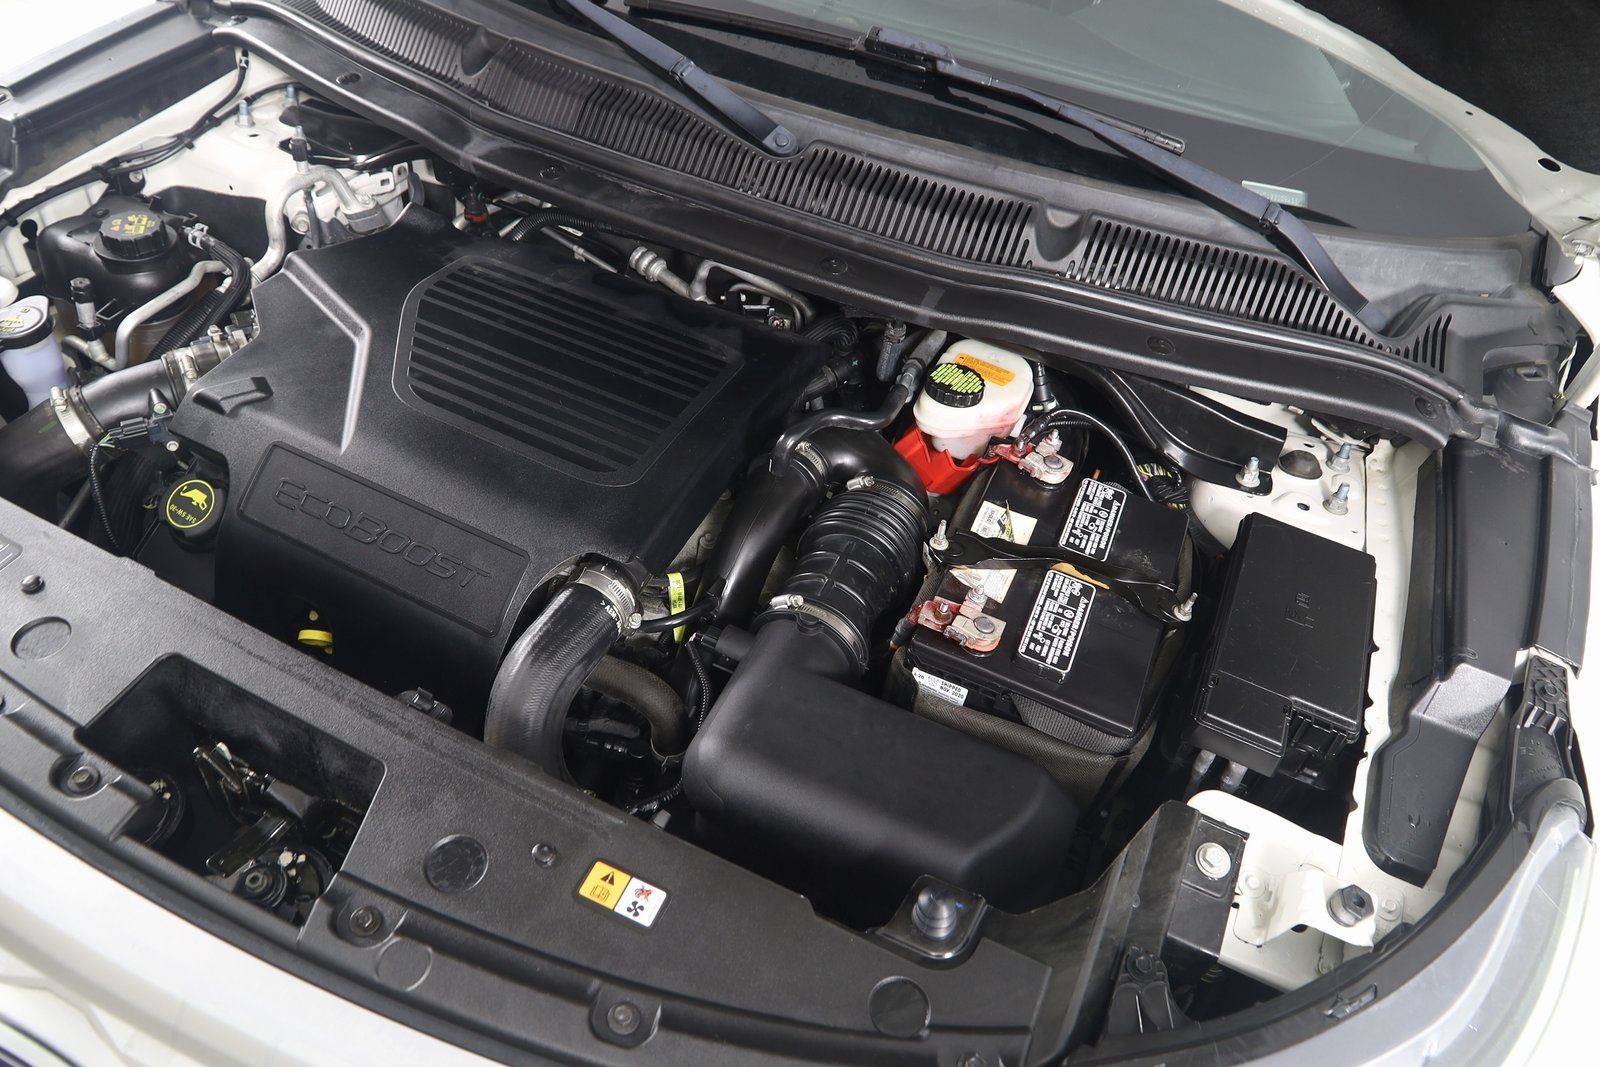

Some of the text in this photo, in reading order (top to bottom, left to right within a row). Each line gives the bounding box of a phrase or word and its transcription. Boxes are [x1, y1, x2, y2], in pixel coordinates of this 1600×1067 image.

[185, 514, 197, 524] SAE
[273, 477, 491, 588] ECOBOOST
[1099, 505, 1118, 549] DANGER/POISON
[1062, 603, 1086, 657] DANGER/POISON
[941, 681, 961, 692] SHIPPED
